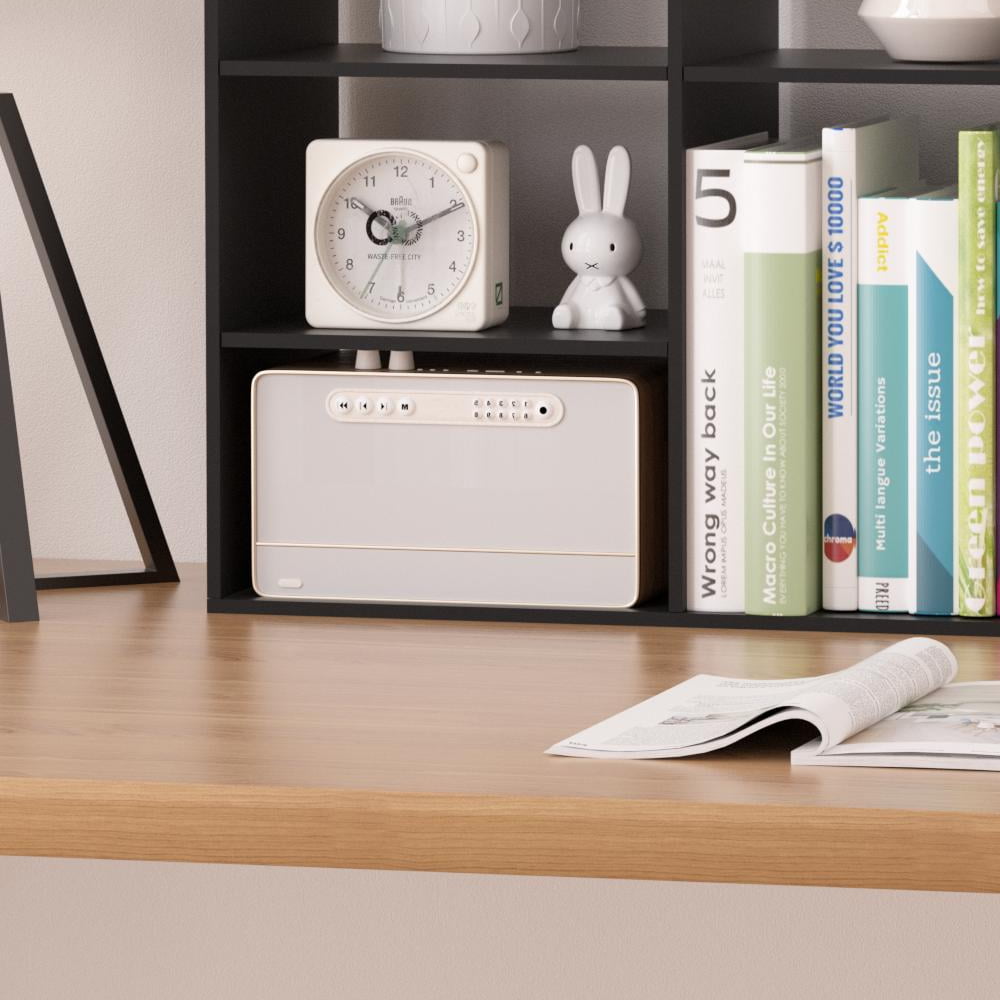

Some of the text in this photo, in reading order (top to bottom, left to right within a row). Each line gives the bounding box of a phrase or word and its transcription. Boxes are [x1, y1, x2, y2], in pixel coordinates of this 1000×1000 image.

[364, 177, 376, 187] 11
[394, 165, 408, 177] 12
[429, 177, 435, 188] 1
[696, 168, 737, 228] 5
[828, 176, 844, 236] 10000
[337, 228, 345, 239] 9
[457, 230, 465, 241] 3
[877, 212, 889, 272] Addict
[975, 138, 987, 316] how to save energy
[346, 259, 353, 270] 8
[449, 261, 456, 272] 4
[828, 258, 844, 303] LOVE
[368, 282, 376, 294] 7
[428, 283, 435, 295] 5
[828, 309, 844, 348] YOU
[828, 353, 844, 419] WORLD
[924, 352, 941, 474] the issue
[701, 368, 720, 599] Wrong way back
[762, 366, 777, 604] Macro Culture In Our Life
[875, 376, 890, 551] Multi langue Variations
[964, 325, 987, 614] Green power
